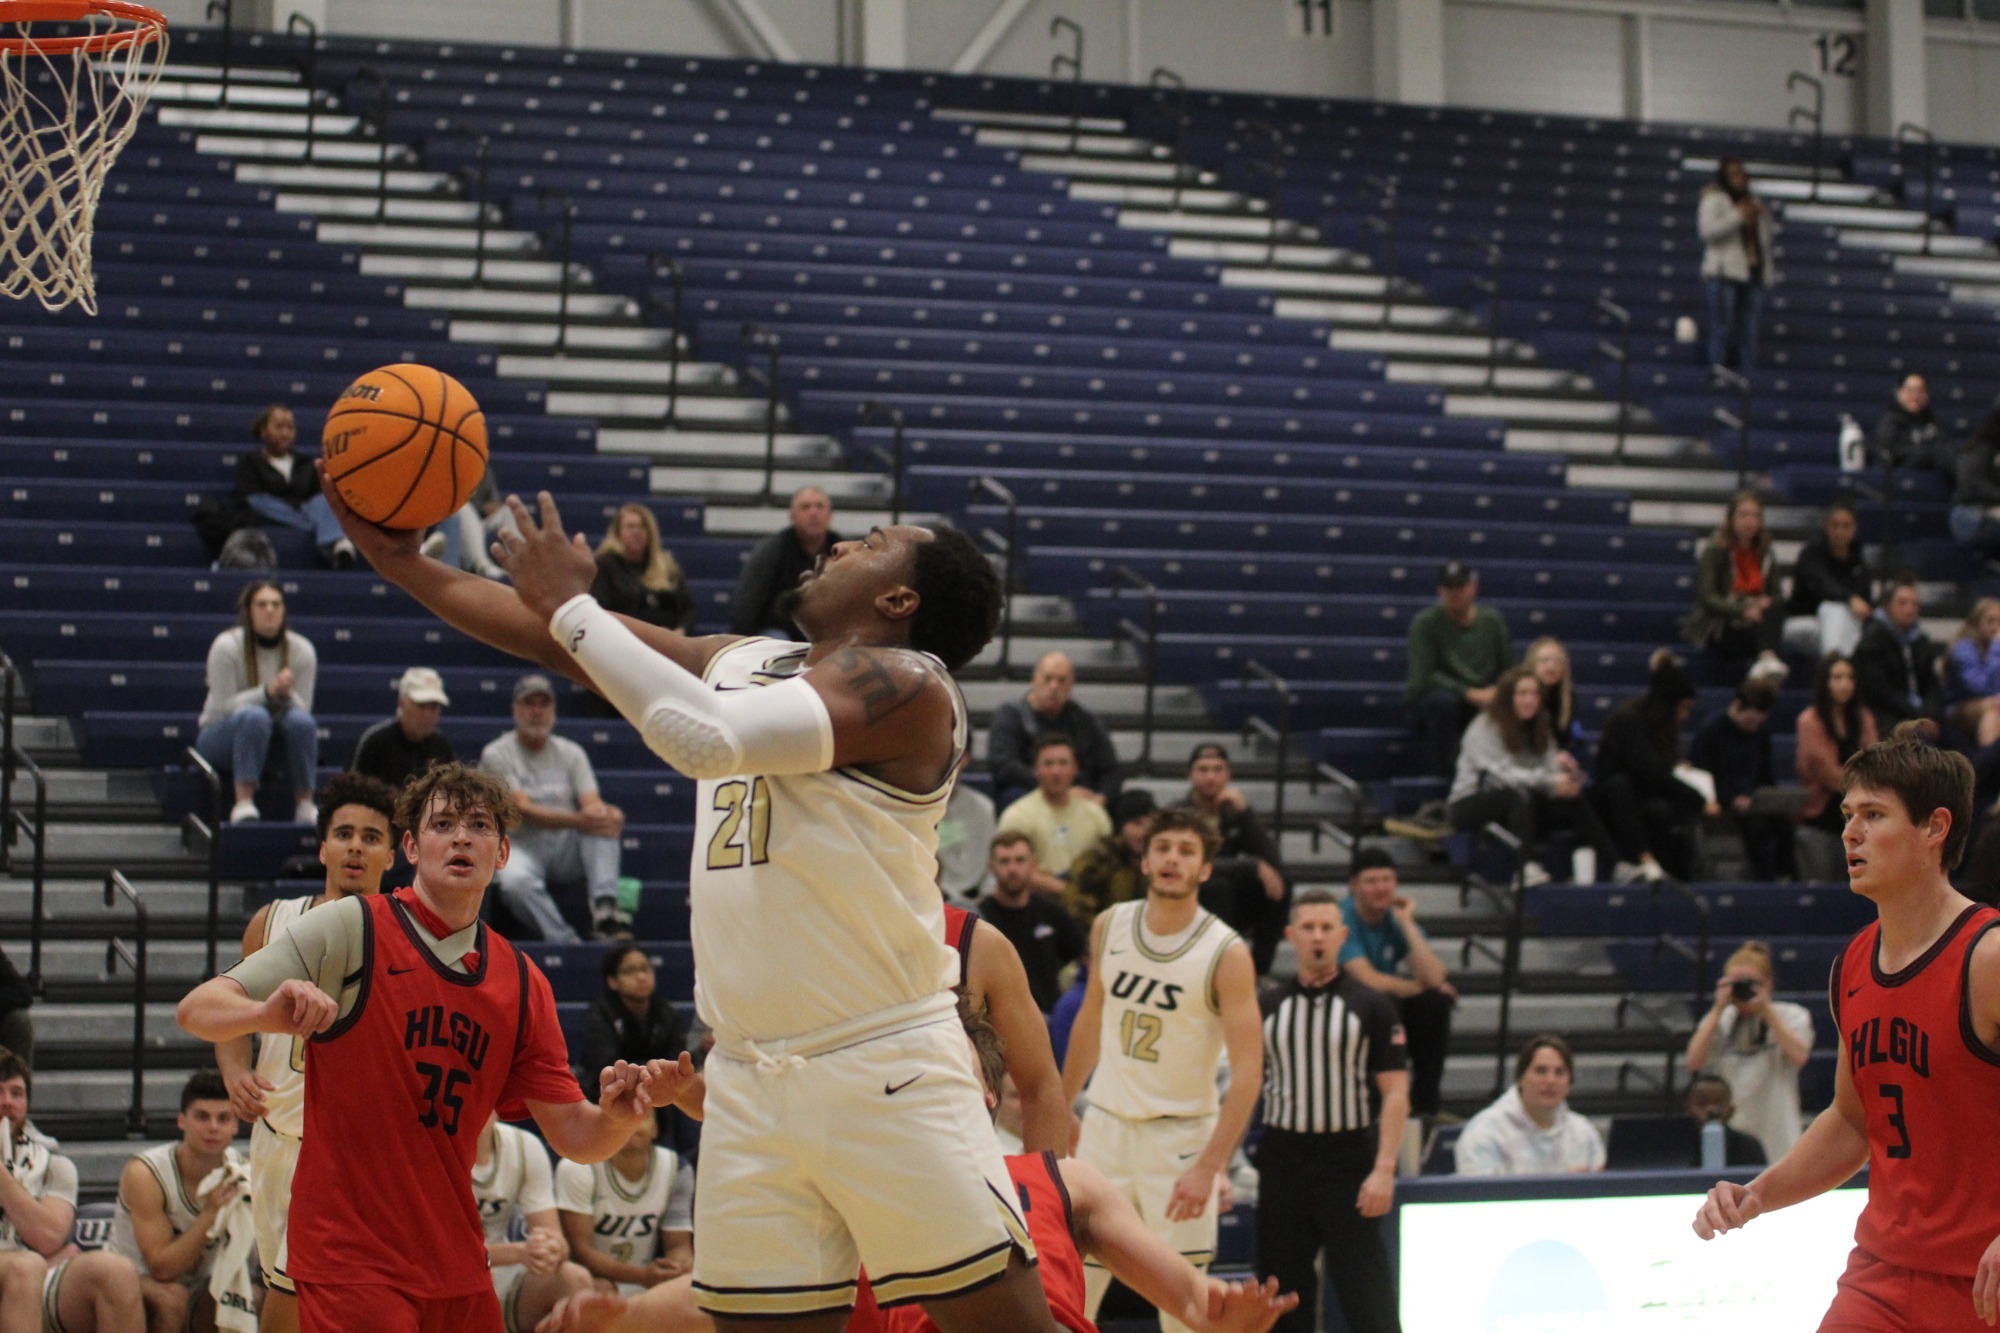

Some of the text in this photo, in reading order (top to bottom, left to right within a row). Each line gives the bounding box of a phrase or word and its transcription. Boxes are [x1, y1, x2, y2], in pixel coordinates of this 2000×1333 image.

[1297, 0, 1331, 35] 11
[1815, 32, 1857, 76] 12
[706, 775, 771, 870] 21
[1110, 971, 1184, 1011] UIS
[405, 1006, 490, 1071] HLGU
[1120, 1009, 1162, 1063] 12
[1851, 1017, 1930, 1078] HLGU
[416, 1061, 472, 1136] 35
[1879, 1084, 1911, 1159] 3
[595, 1213, 657, 1236] UIS
